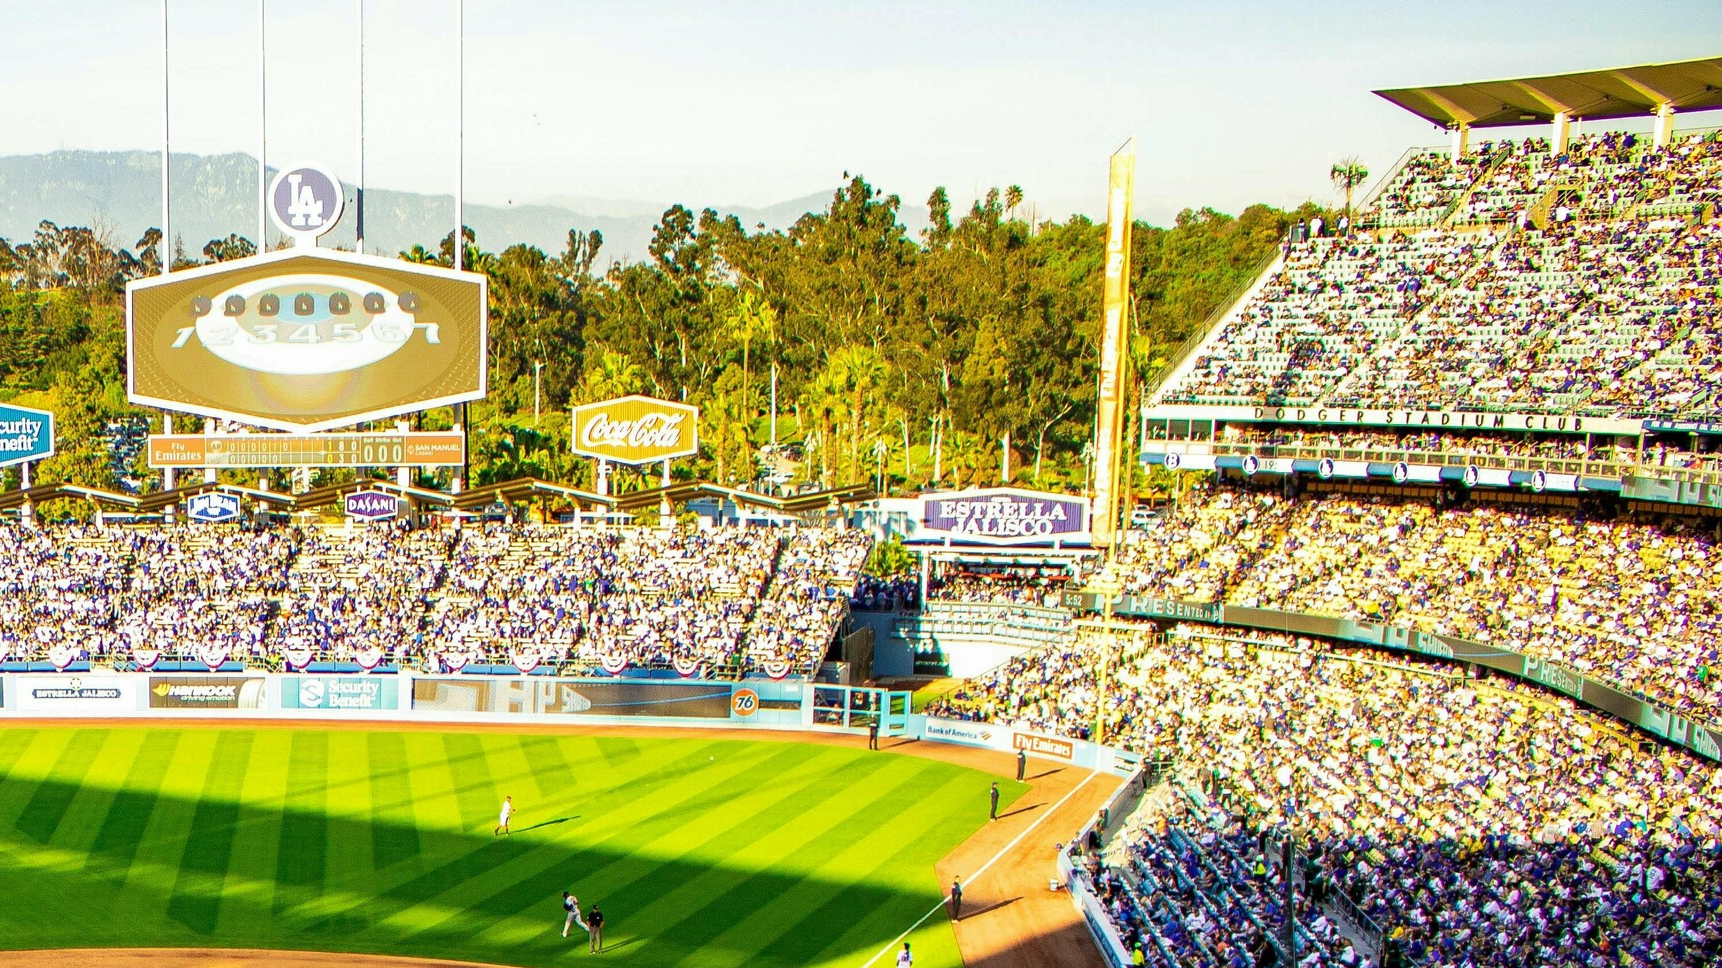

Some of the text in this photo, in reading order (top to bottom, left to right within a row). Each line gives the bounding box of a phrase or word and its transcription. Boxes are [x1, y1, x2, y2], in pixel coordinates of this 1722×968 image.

[288, 173, 324, 227] LA
[171, 326, 196, 348] 1
[248, 324, 278, 344] 3
[286, 323, 322, 344] 4
[331, 322, 363, 344] 5
[413, 322, 441, 345] 7
[1254, 406, 1582, 432] DODGER STADIUM CLUB
[171, 442, 185, 451] Fly
[155, 451, 202, 461] Emirates
[349, 497, 395, 513] DASANI
[939, 501, 1067, 520] ESTRELLA
[951, 518, 1054, 536] JALISCO
[169, 685, 237, 697] HANKOOK
[329, 680, 379, 696] Security
[329, 693, 373, 707] Benefit
[735, 694, 755, 711] 76
[927, 726, 944, 734] Bank
[952, 729, 978, 740] America
[1016, 734, 1071, 756] Fly Emirates
